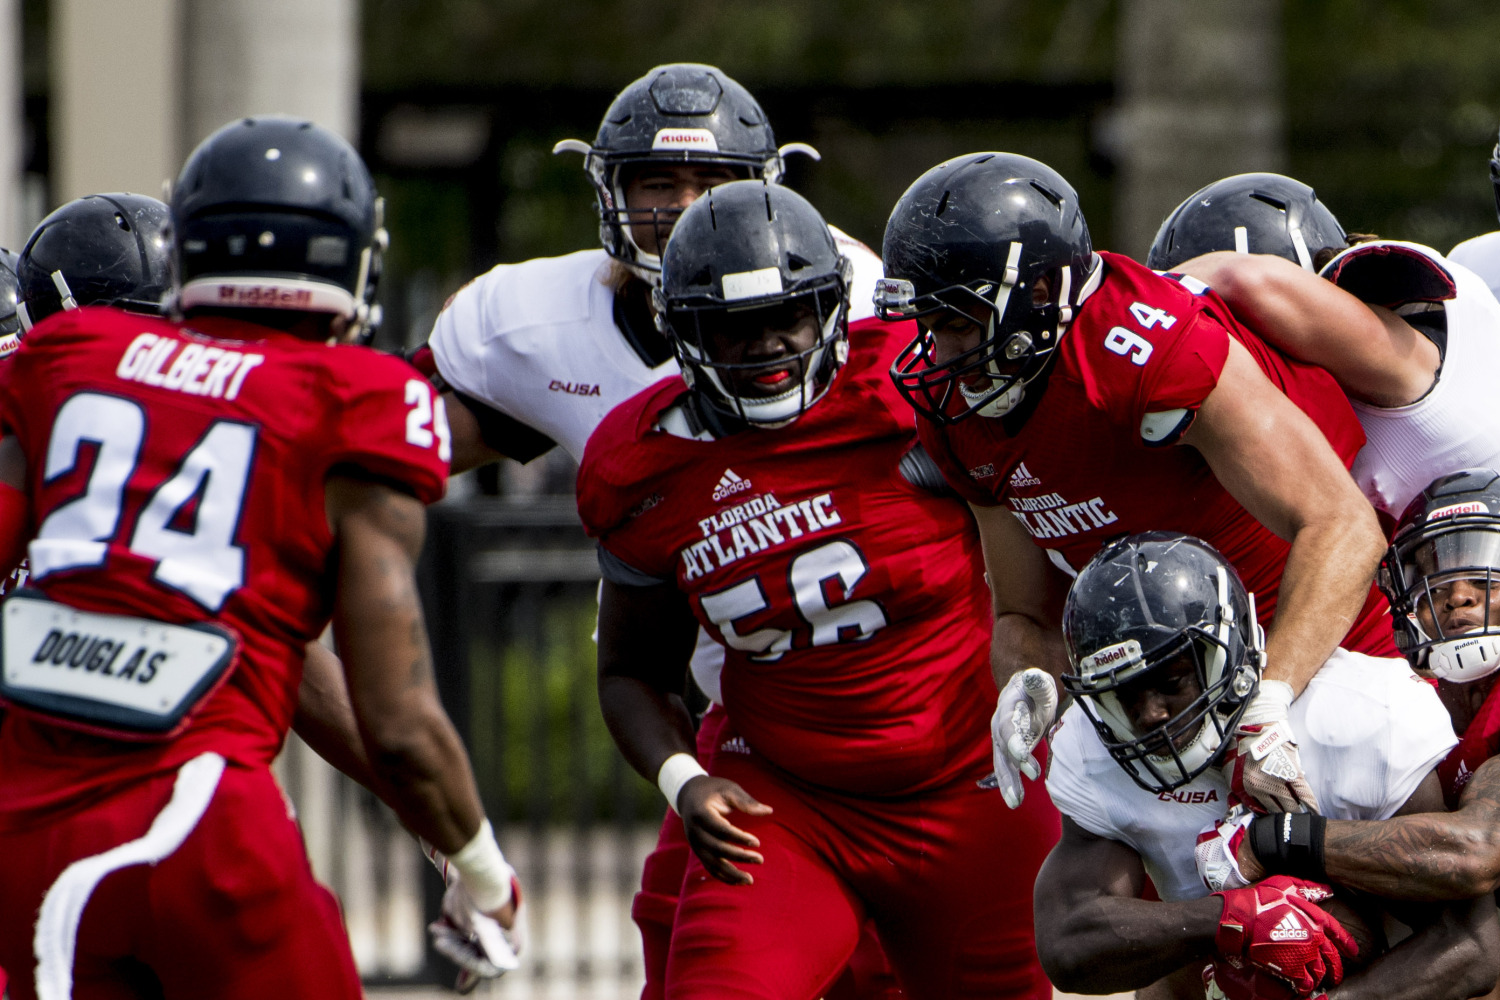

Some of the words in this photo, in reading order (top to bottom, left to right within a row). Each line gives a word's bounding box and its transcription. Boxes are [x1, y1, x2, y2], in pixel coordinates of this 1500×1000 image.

[218, 285, 313, 307] Riddell
[1103, 301, 1178, 367] 94
[116, 332, 266, 401] GILBERT
[711, 477, 753, 502] adidas
[1009, 477, 1042, 488] adidas
[27, 389, 262, 616] 24
[698, 492, 782, 538] FLORIDA
[1008, 492, 1068, 512] FLORIDA
[1011, 496, 1119, 539] LANTIC
[1431, 503, 1481, 520] Riddell
[680, 493, 842, 582] ATLANTIC
[698, 537, 890, 663] 56
[32, 625, 169, 685] DOUGLAS
[1094, 646, 1127, 668] Riddell
[1454, 639, 1479, 651] Riddell
[1270, 928, 1308, 939] adidas
